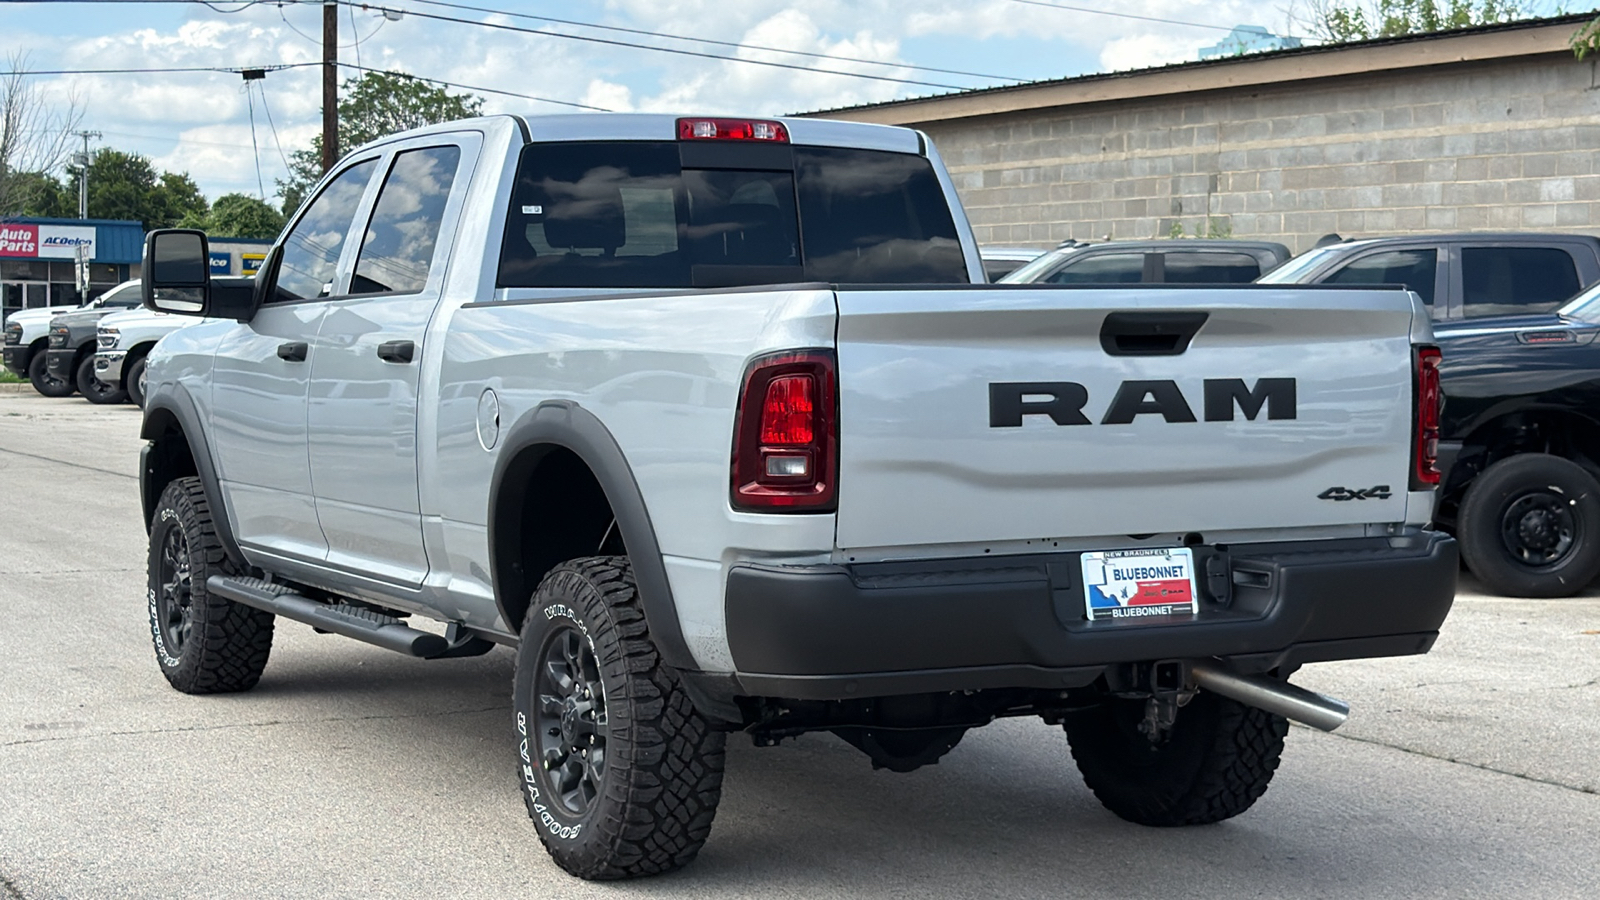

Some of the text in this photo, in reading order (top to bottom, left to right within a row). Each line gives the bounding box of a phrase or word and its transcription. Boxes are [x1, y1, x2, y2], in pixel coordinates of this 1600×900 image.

[0, 229, 32, 240] Auto
[0, 240, 35, 252] Parts
[44, 237, 92, 246] ACDelco
[988, 378, 1297, 427] RAM
[1316, 485, 1392, 501] 4x4
[1125, 549, 1169, 557] BRAUNFELS
[1113, 566, 1184, 580] BLUEBONNET
[1112, 606, 1172, 617] BLUEBONNET
[517, 711, 582, 839] GOODYEAR
